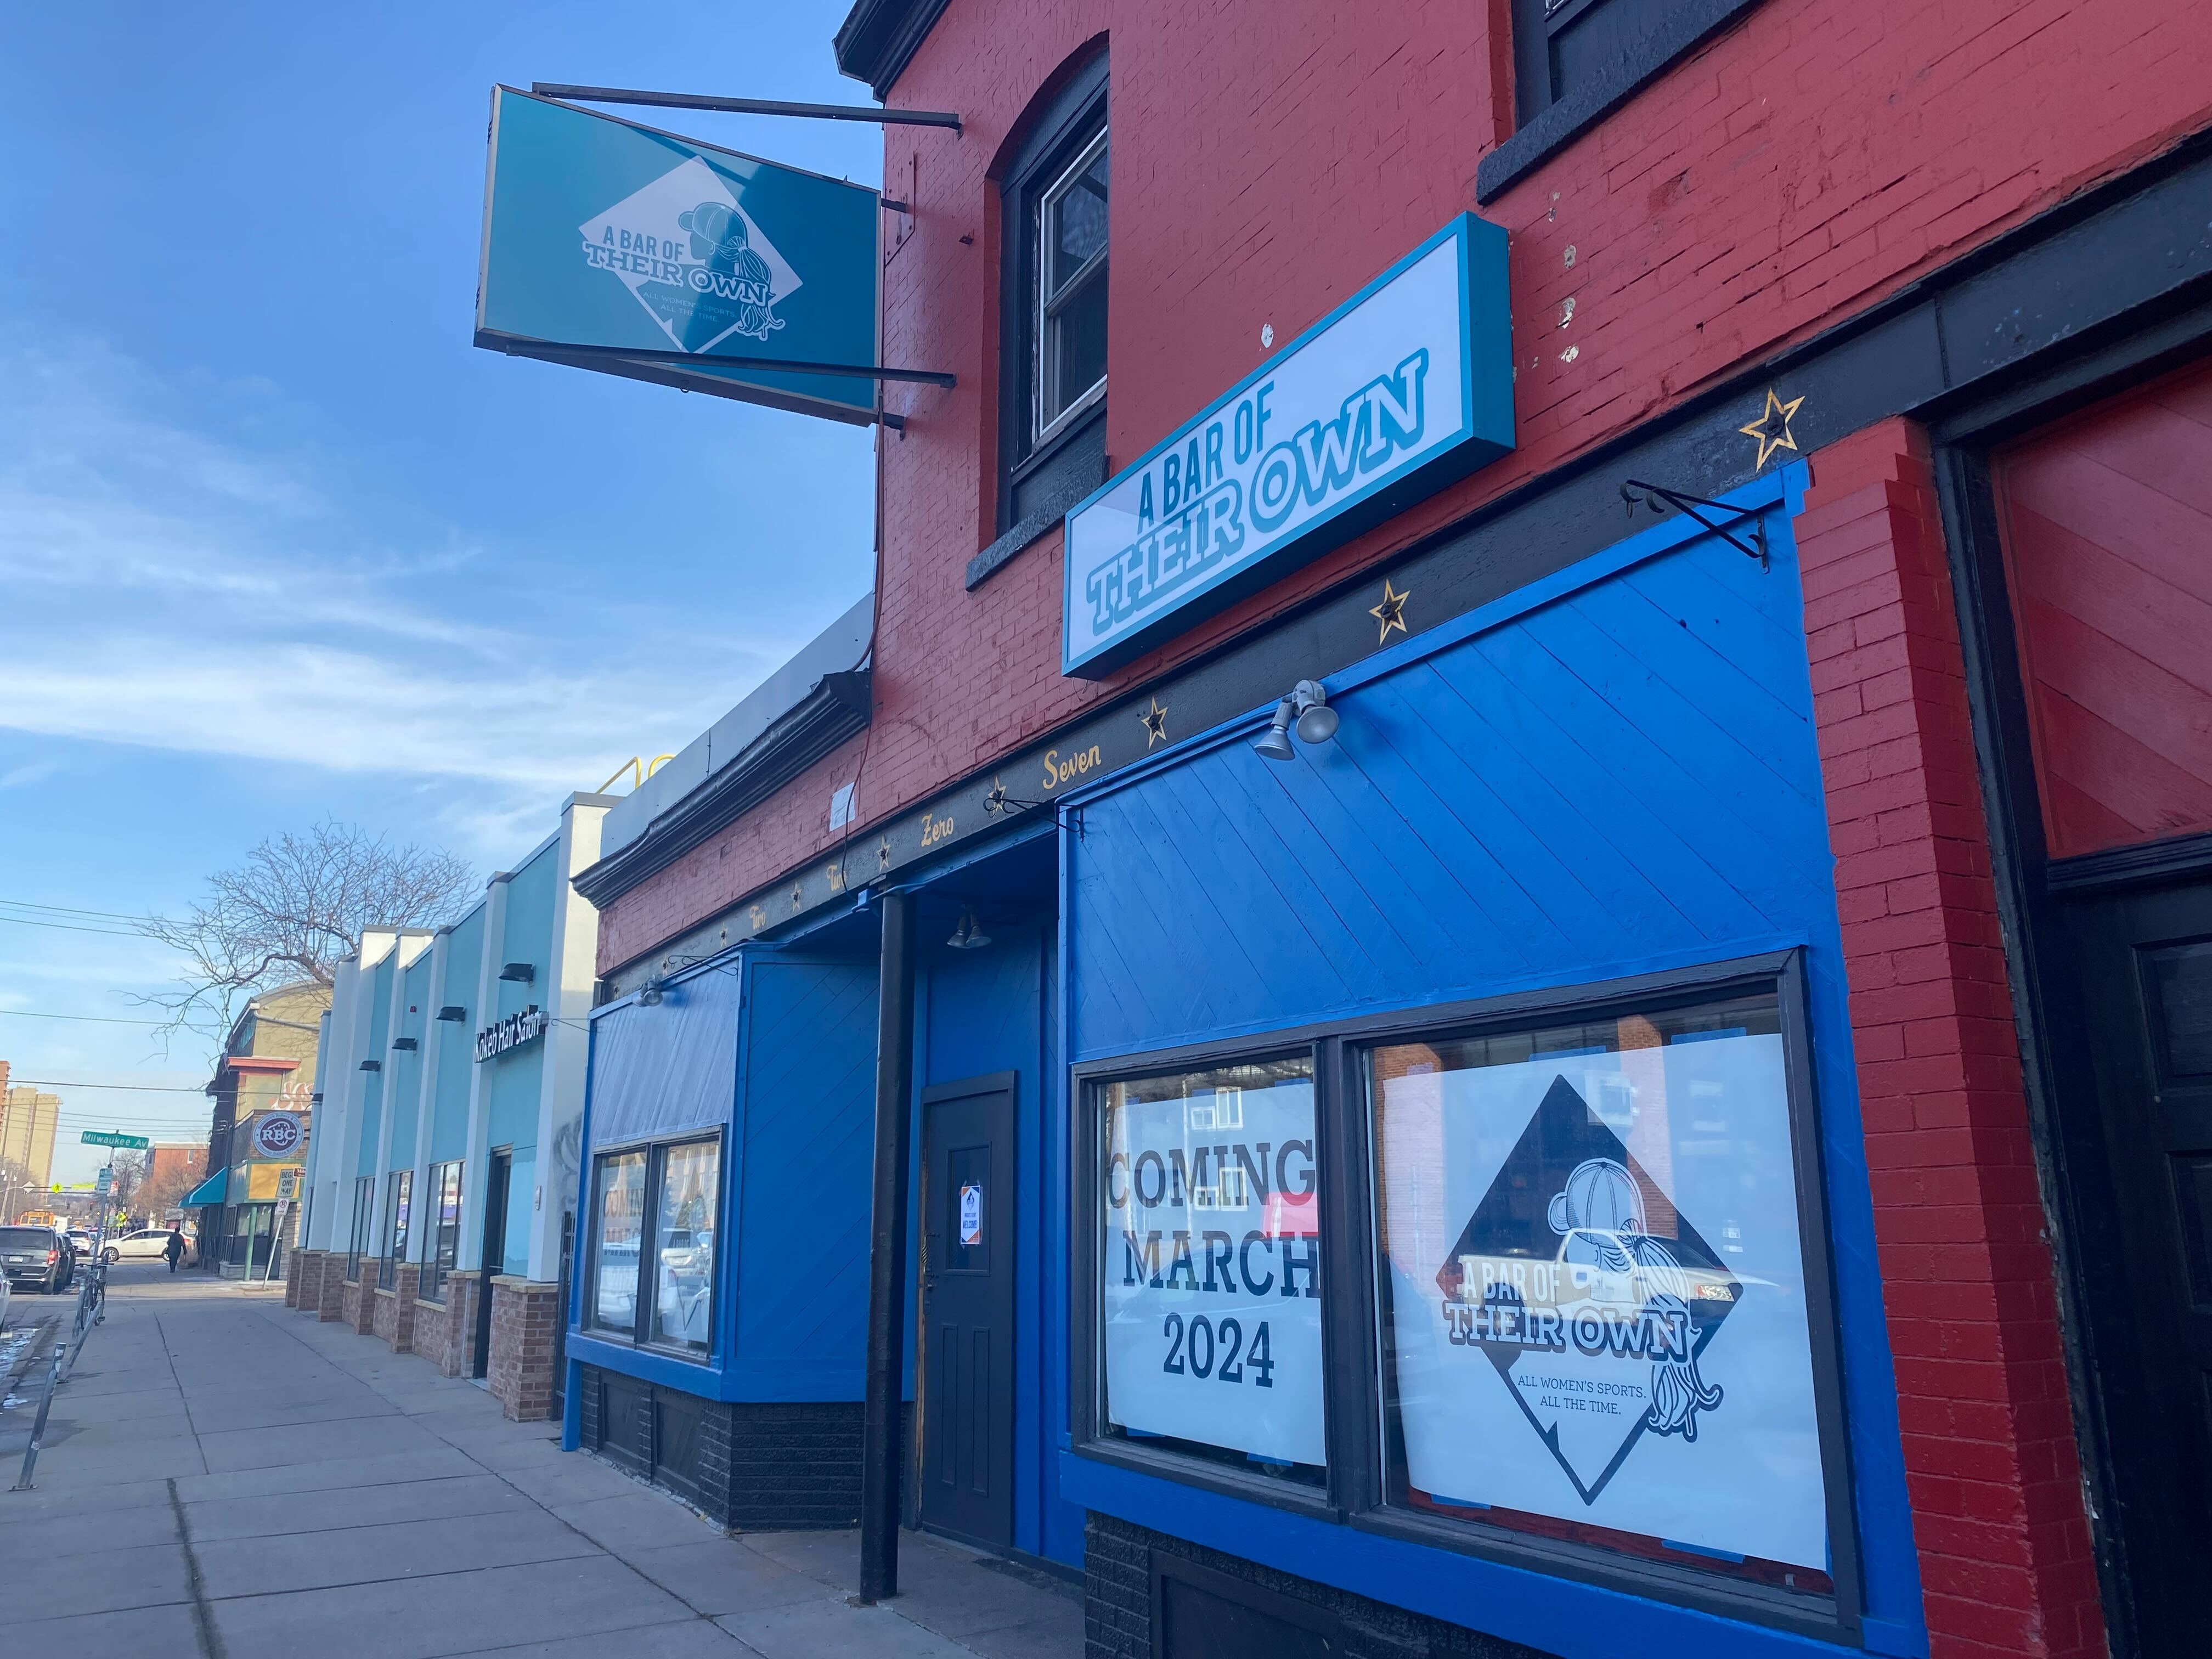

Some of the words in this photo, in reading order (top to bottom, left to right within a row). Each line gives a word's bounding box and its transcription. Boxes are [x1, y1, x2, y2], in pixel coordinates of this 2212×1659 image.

[603, 226, 614, 246] A
[620, 229, 657, 256] BAR
[663, 240, 684, 261] OF
[583, 241, 684, 286] THEIR
[689, 268, 768, 307] OWN
[660, 304, 676, 313] ALL
[678, 308, 694, 317] THE
[661, 295, 701, 309] WOMEN'S
[1137, 471, 1154, 535] A
[1164, 421, 1223, 516] BAR
[1234, 380, 1274, 465] OF
[1086, 478, 1245, 637] THEIR
[1249, 348, 1429, 533] OWN
[749, 905, 766, 930] Two
[919, 814, 953, 848] Zero
[1043, 745, 1101, 789] Seven
[475, 1023, 497, 1063] Kokeb
[498, 1014, 515, 1053] Hair
[83, 1133, 131, 1146] Milwaukee
[134, 1139, 147, 1147] Av
[261, 1129, 296, 1141] RBC
[1109, 1139, 1316, 1209] COMING
[603, 1188, 644, 1217] COMIN
[1122, 1230, 1321, 1299] MARCH
[1463, 1262, 1476, 1299] A
[1481, 1263, 1527, 1301] BAR
[1533, 1263, 1561, 1302] OF
[1163, 1312, 1274, 1388] 2024
[1442, 1299, 1566, 1353] THEIR
[1571, 1305, 1692, 1363] OWN
[1517, 1375, 1537, 1387] ALL
[1540, 1377, 1594, 1393] WOMEN'S
[1597, 1383, 1646, 1398] SPORTS.
[1540, 1395, 1560, 1408] ALL
[1563, 1398, 1586, 1410] THE
[1589, 1400, 1621, 1415] TIME.
